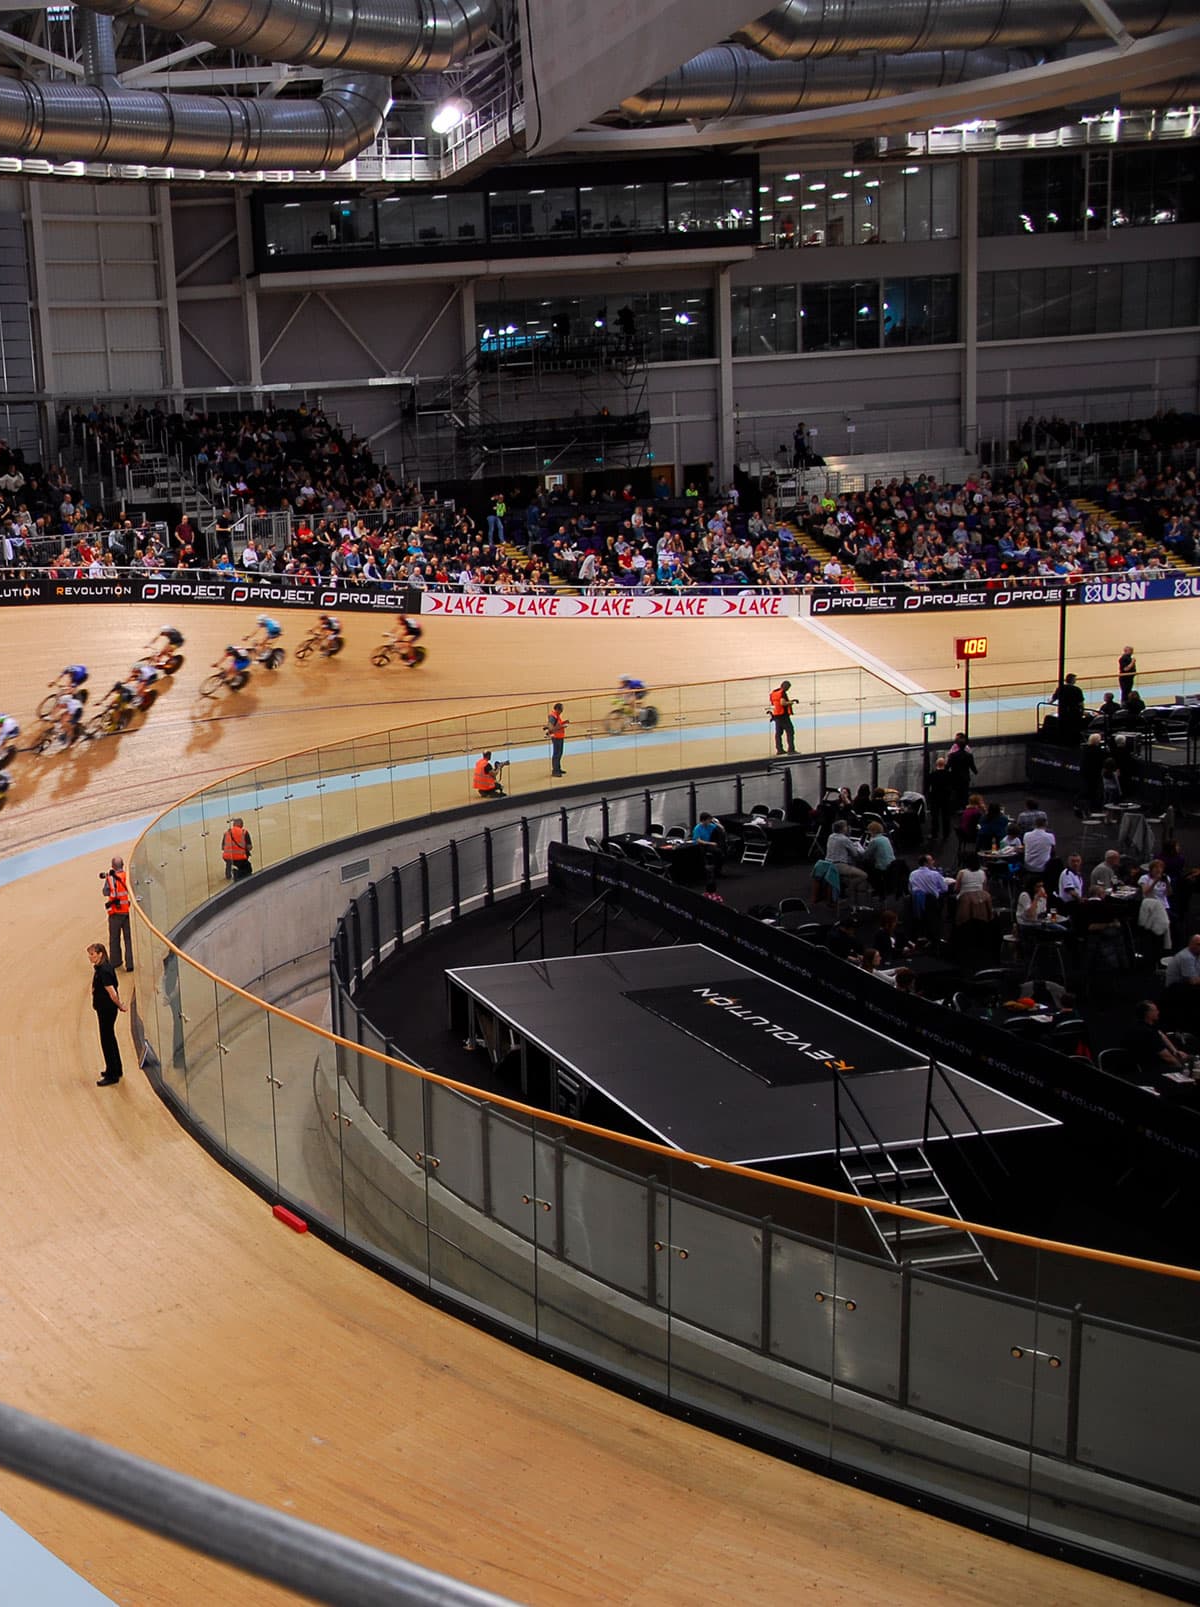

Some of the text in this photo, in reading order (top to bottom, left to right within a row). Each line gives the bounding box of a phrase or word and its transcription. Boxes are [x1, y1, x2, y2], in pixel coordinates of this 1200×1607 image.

[56, 585, 132, 597] REVOLUTION
[160, 584, 226, 597] PROJECT
[250, 587, 315, 601] PROJECT
[922, 592, 987, 605] PROJECT
[1102, 580, 1147, 601] USN
[339, 592, 405, 606] PROJECT
[444, 596, 488, 614] LAKE
[517, 597, 561, 616] LAKE
[590, 597, 634, 616] LAKE
[664, 597, 708, 616] LAKE
[738, 597, 782, 615] LAKE
[831, 596, 897, 608] PROJECT
[964, 639, 987, 654] 108
[692, 987, 856, 1072] REVOLUTION
